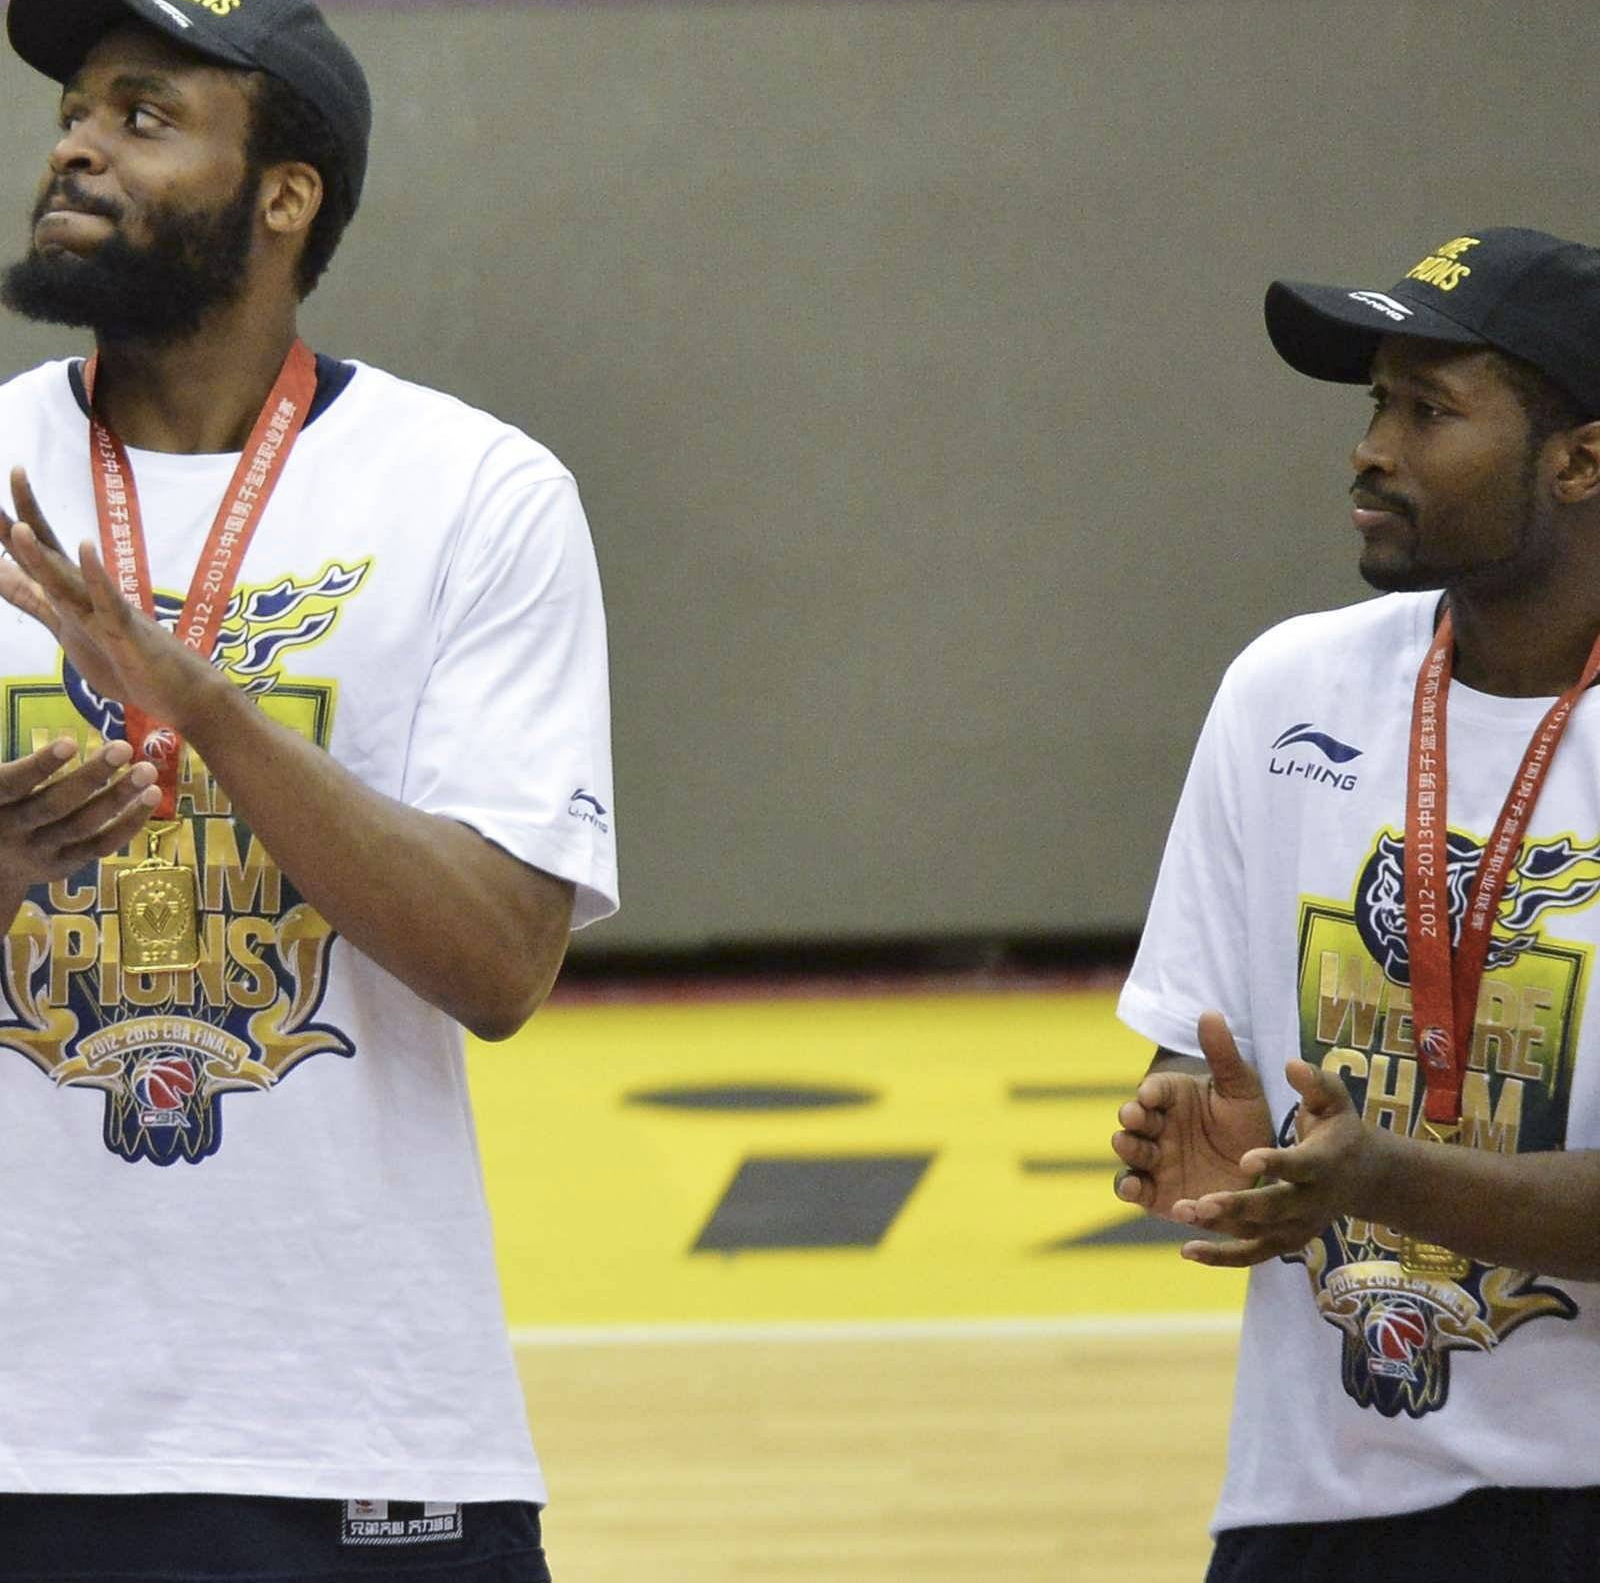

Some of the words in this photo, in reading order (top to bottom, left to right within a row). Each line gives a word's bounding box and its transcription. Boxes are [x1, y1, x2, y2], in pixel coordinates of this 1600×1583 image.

[85, 1019, 159, 1059] 2012-2013
[163, 1022, 191, 1043] CBA
[193, 1024, 242, 1061] FINALS
[1470, 979, 1554, 1081] RE
